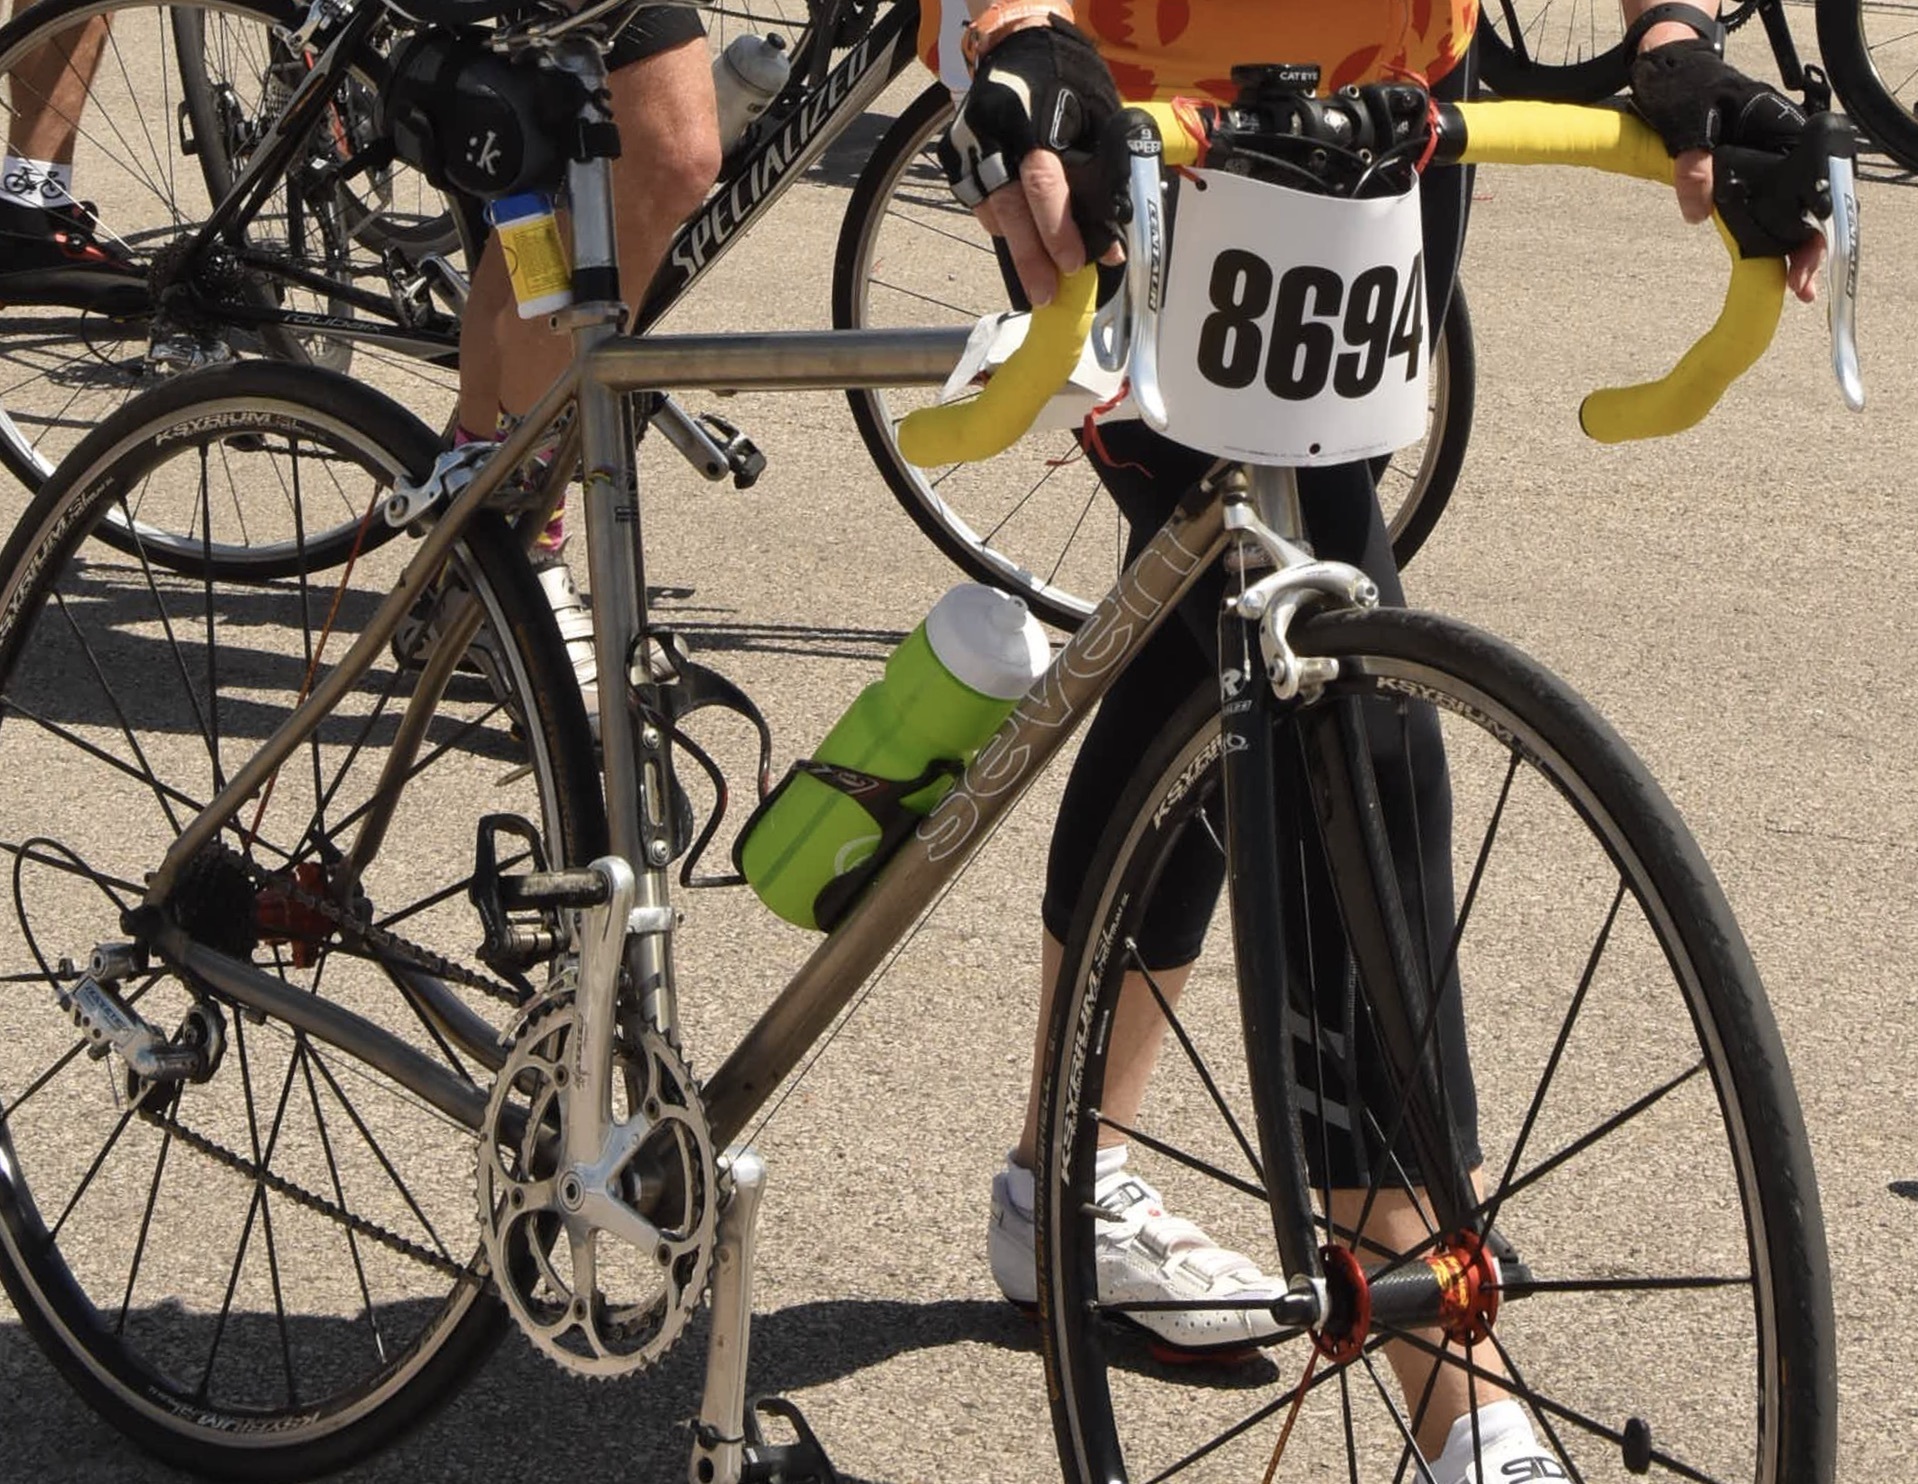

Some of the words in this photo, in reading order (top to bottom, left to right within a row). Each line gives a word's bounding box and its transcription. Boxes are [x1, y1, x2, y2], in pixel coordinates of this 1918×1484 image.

[1140, 128, 1152, 140] 9
[1279, 71, 1319, 82] CATEYE
[672, 38, 870, 289] SPECIALIZED
[1147, 198, 1161, 313] CENTAUR
[1197, 248, 1424, 402] 8694
[155, 411, 271, 447] KSYRIUM
[0, 516, 66, 645] SYRIUM
[916, 528, 1199, 862] seven
[1376, 676, 1516, 743] KSYRIUM
[1153, 733, 1222, 830] KSYRI
[1061, 969, 1098, 1187] KSYRIUM
